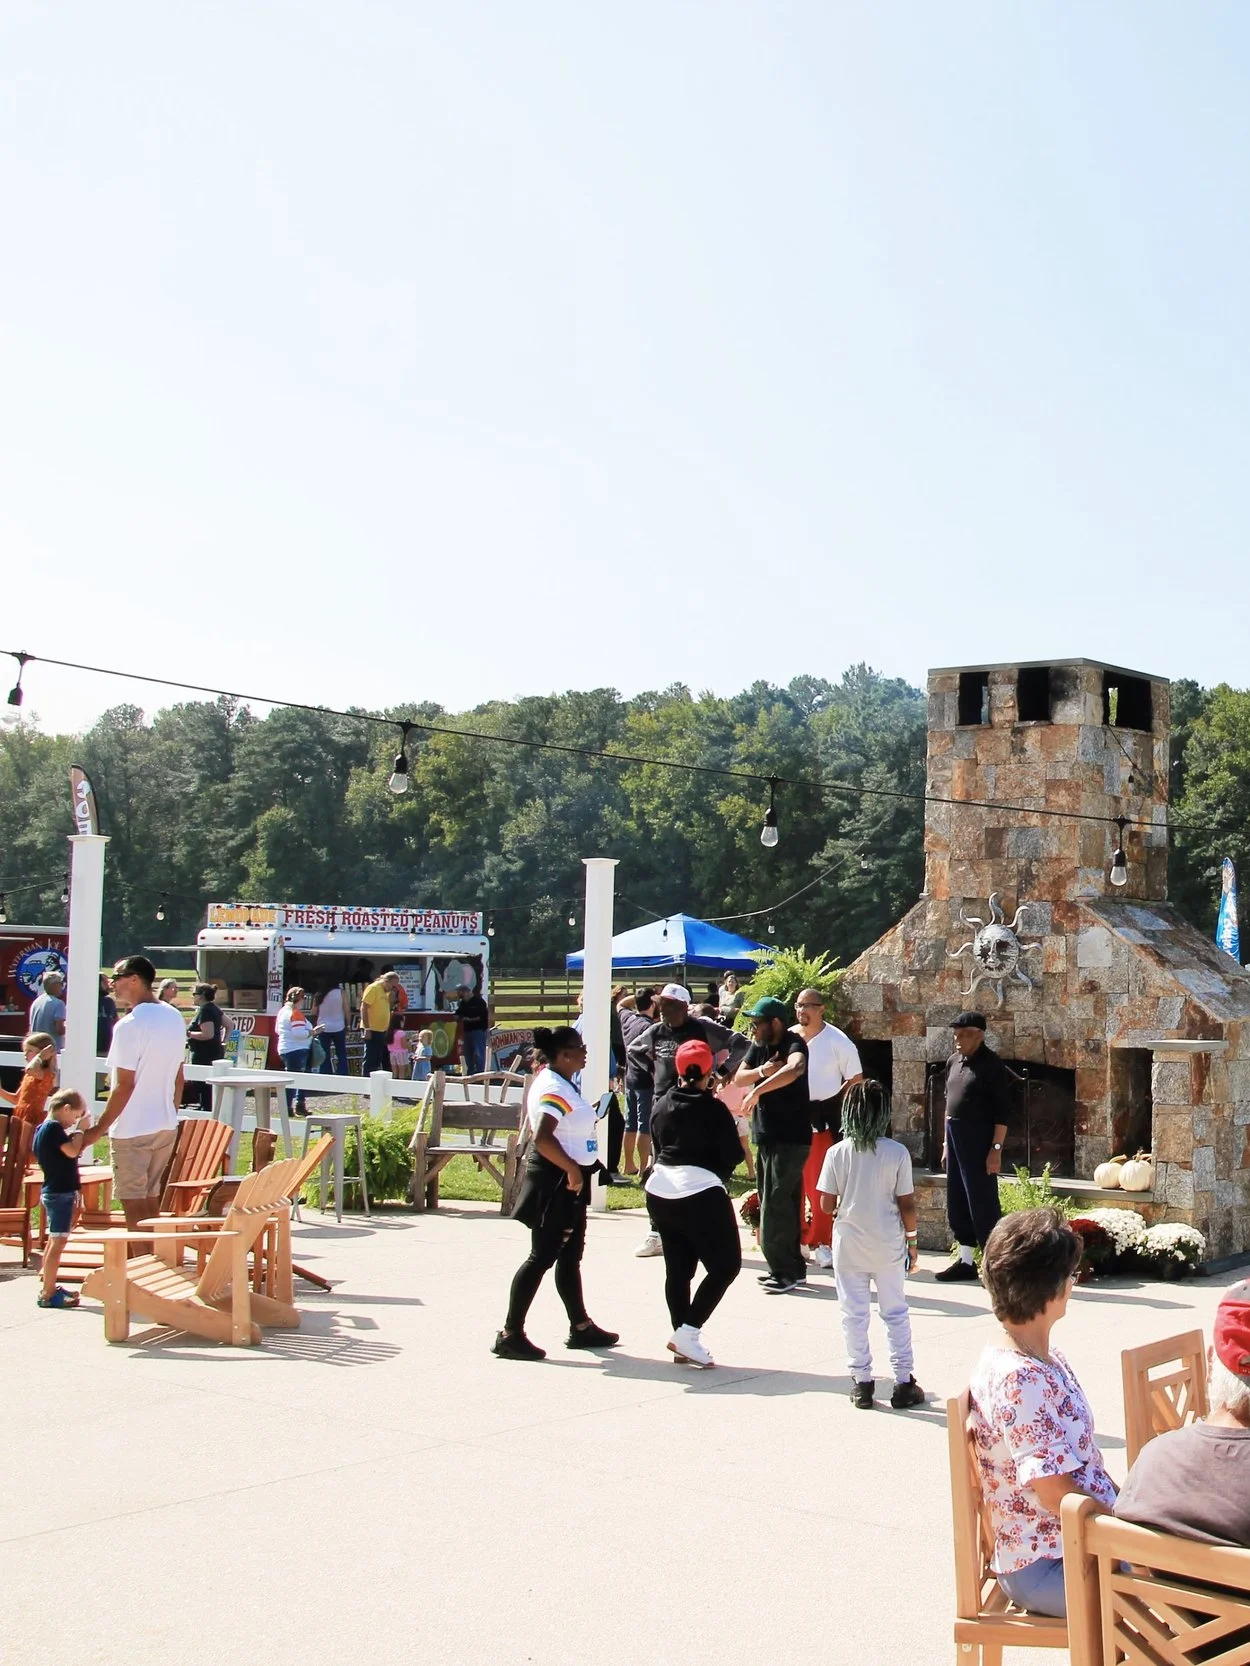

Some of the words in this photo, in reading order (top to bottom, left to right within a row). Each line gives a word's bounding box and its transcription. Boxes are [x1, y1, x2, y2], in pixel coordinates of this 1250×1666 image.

[285, 910, 336, 925] FRESH
[341, 911, 409, 927] ROASTED
[413, 914, 478, 929] PEANUTS
